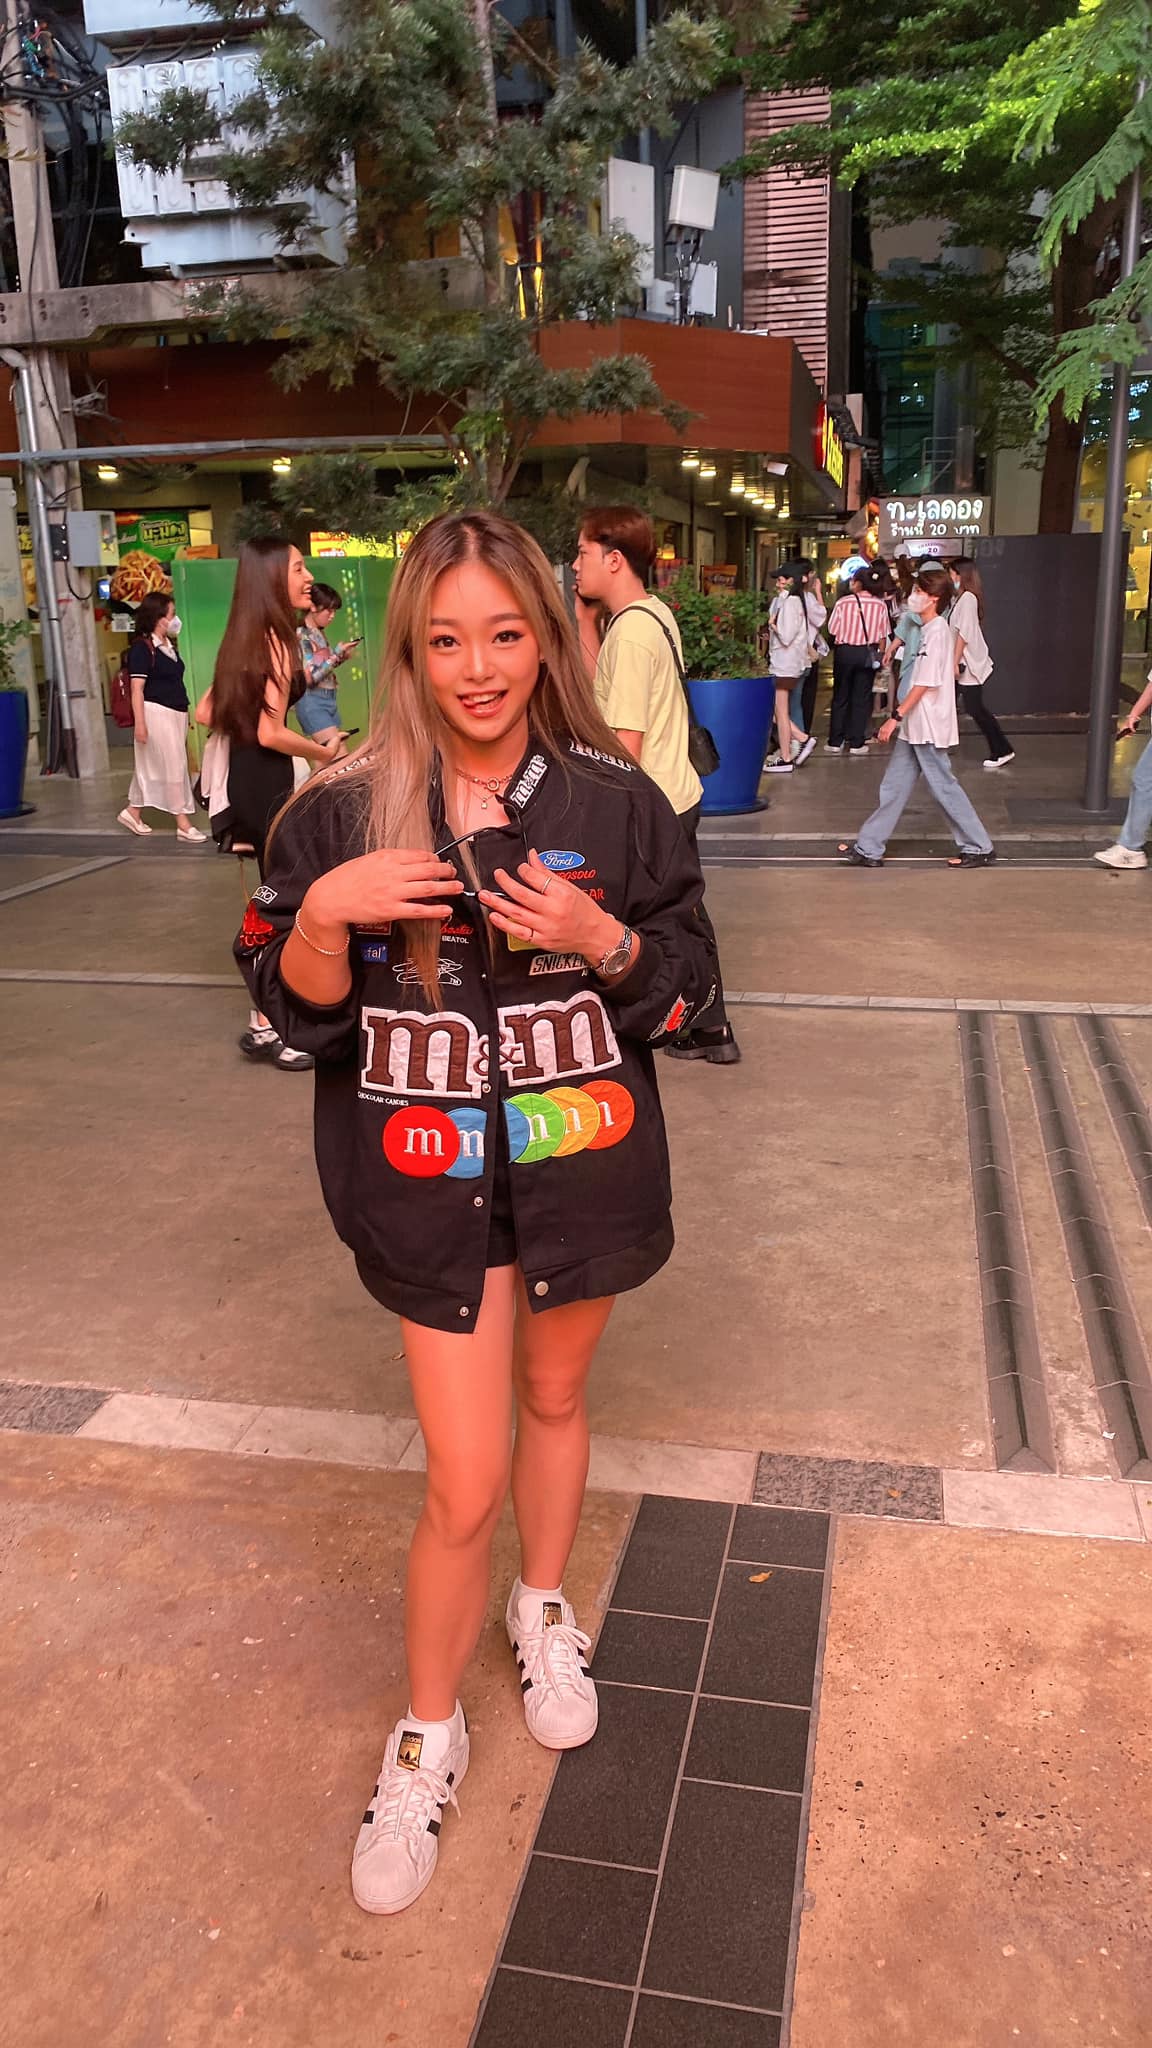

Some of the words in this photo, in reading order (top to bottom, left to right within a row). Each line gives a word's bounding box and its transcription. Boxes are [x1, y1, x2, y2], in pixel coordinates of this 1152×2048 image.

[886, 499, 983, 521] ทะเลดอง
[929, 524, 947, 536] 20
[953, 524, 980, 536] บาท
[543, 853, 575, 866] Ford
[532, 953, 585, 973] SNICKE
[403, 1127, 445, 1156] m
